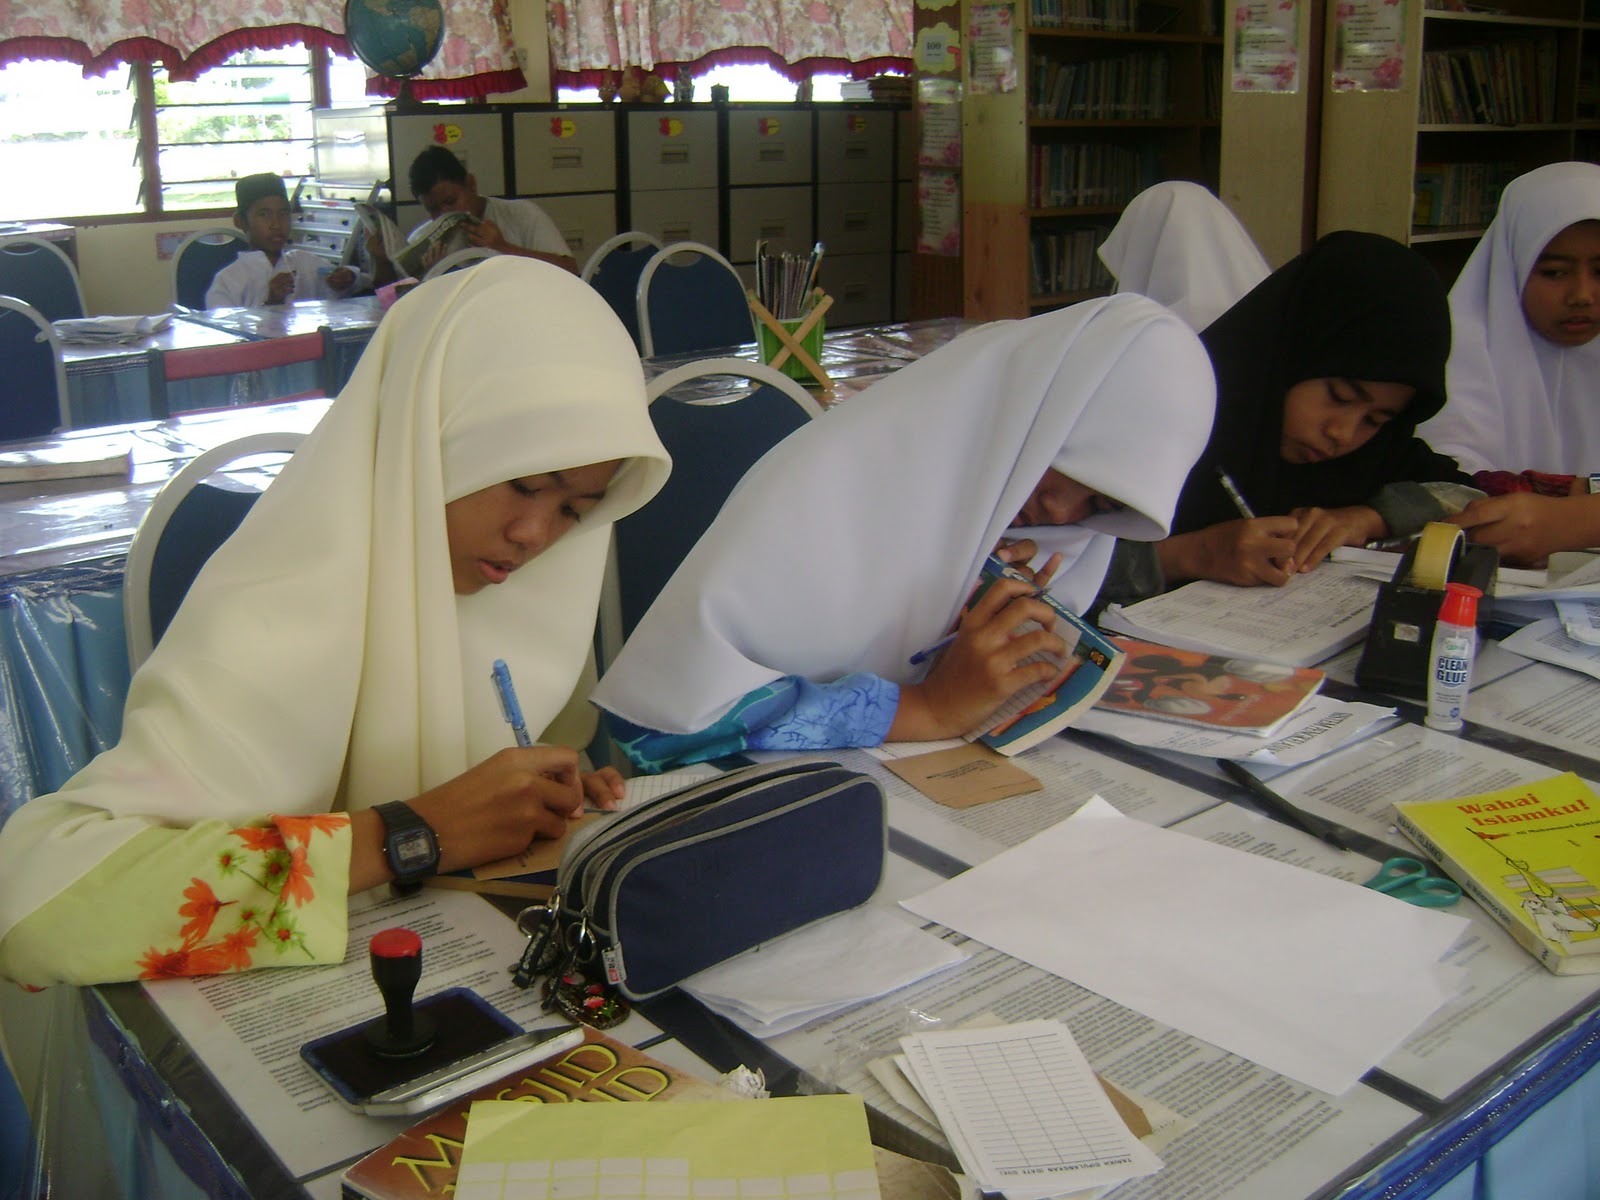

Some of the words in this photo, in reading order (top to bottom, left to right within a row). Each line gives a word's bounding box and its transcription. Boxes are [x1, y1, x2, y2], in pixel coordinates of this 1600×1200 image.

[1438, 656, 1468, 671] CLEAN
[1436, 669, 1467, 683] GLUE
[1456, 793, 1541, 815] Wahai
[1472, 799, 1591, 827] Islamku!
